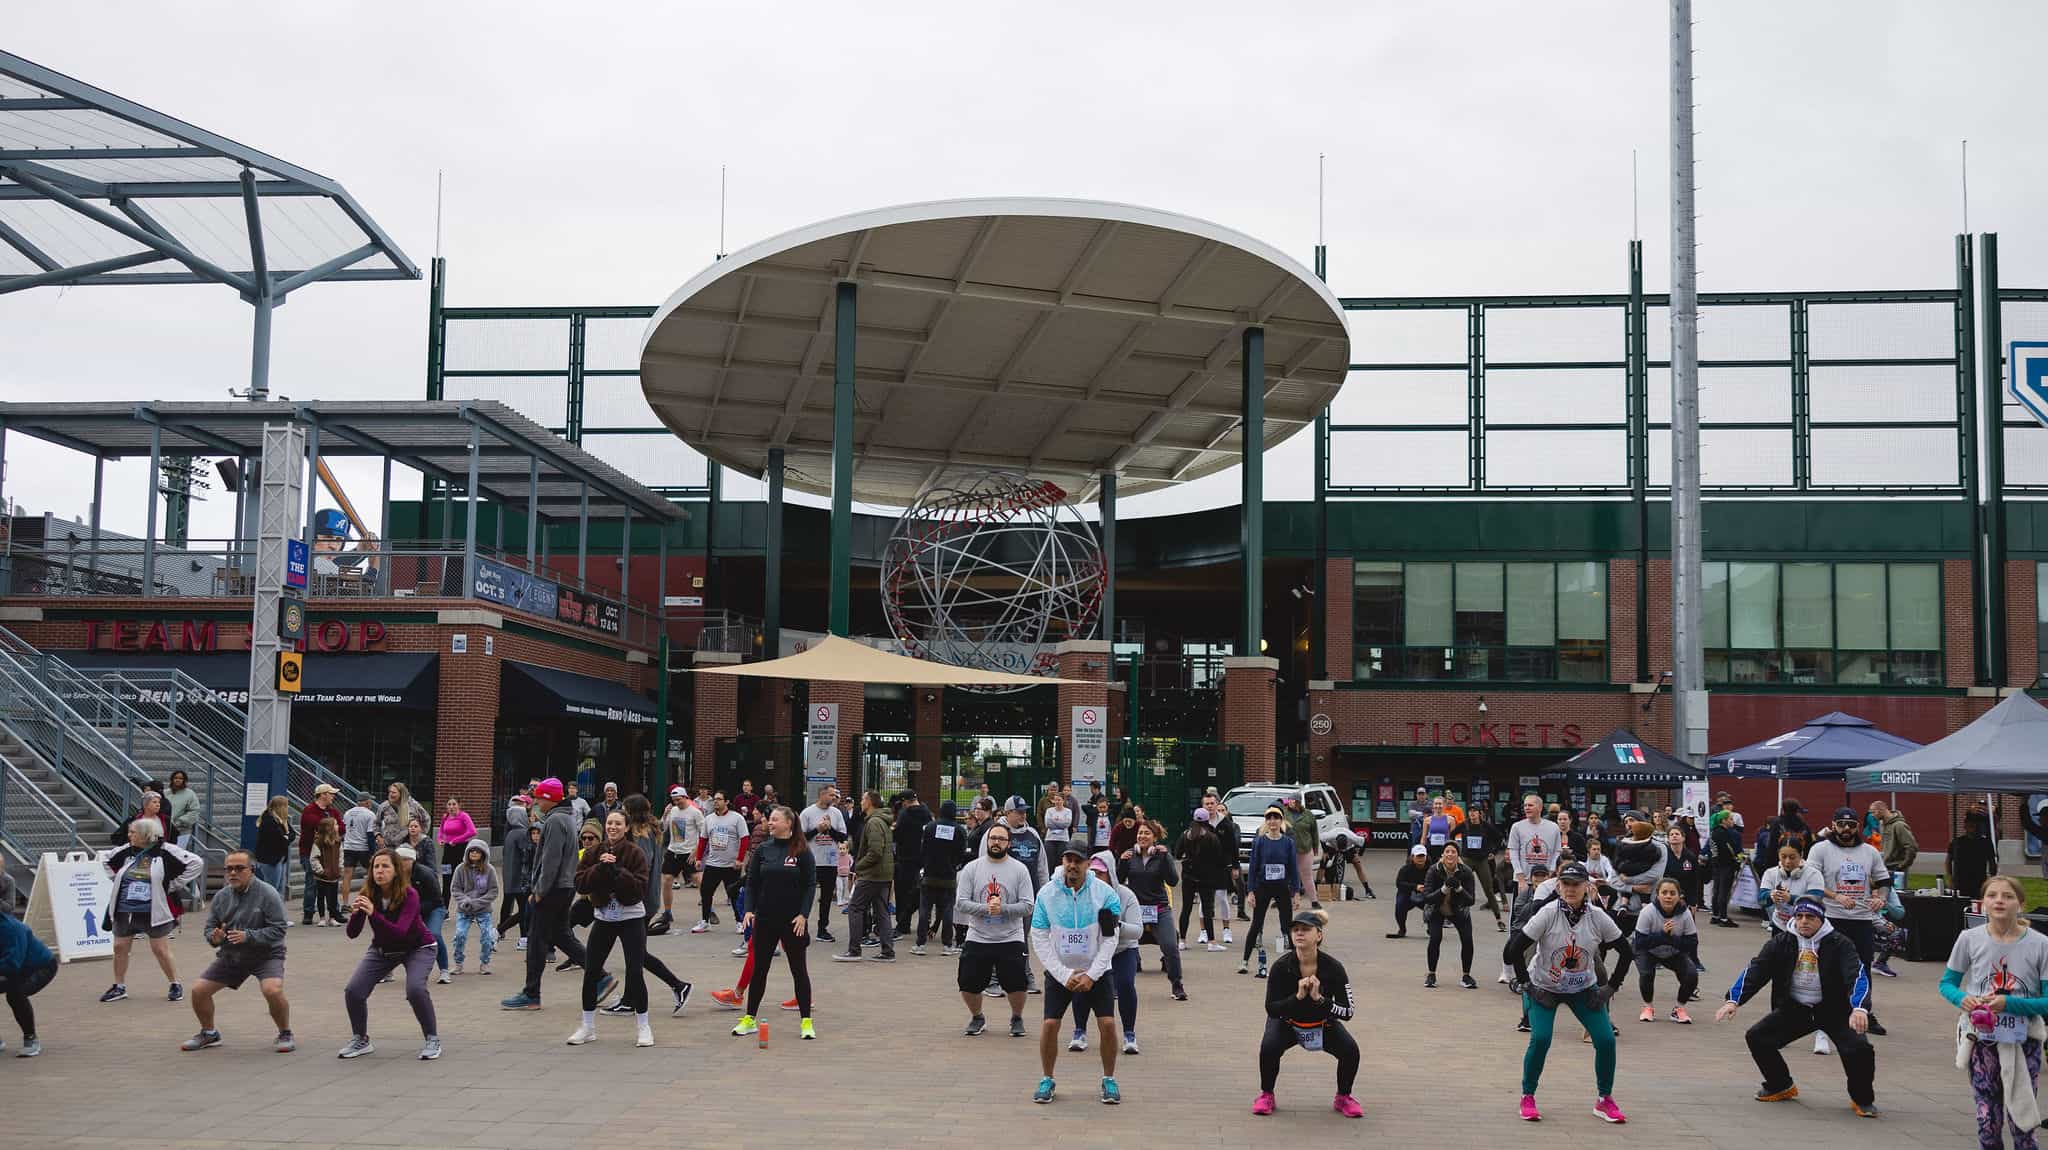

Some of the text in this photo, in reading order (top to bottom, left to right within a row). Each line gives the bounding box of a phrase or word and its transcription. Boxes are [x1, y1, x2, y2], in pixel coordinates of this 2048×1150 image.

[289, 561, 305, 574] THE
[475, 582, 497, 597] OCT.
[605, 606, 619, 619] OCT.
[80, 619, 386, 654] TEAM OP
[139, 689, 249, 703] RENO ACES
[316, 694, 335, 702] TEAM
[336, 694, 355, 702] SHOP
[377, 694, 402, 703] WORLD
[607, 707, 622, 721] RENO
[628, 710, 641, 723] ACES
[1311, 720, 1330, 729] 250
[1407, 722, 1583, 747] TICKETS
[1577, 773, 1697, 782] WWW.STRETCHLABCOM
[1881, 771, 1921, 785] CHIROFIT
[1371, 831, 1409, 840] TOYOTA
[76, 938, 111, 946] UPSTAIRS
